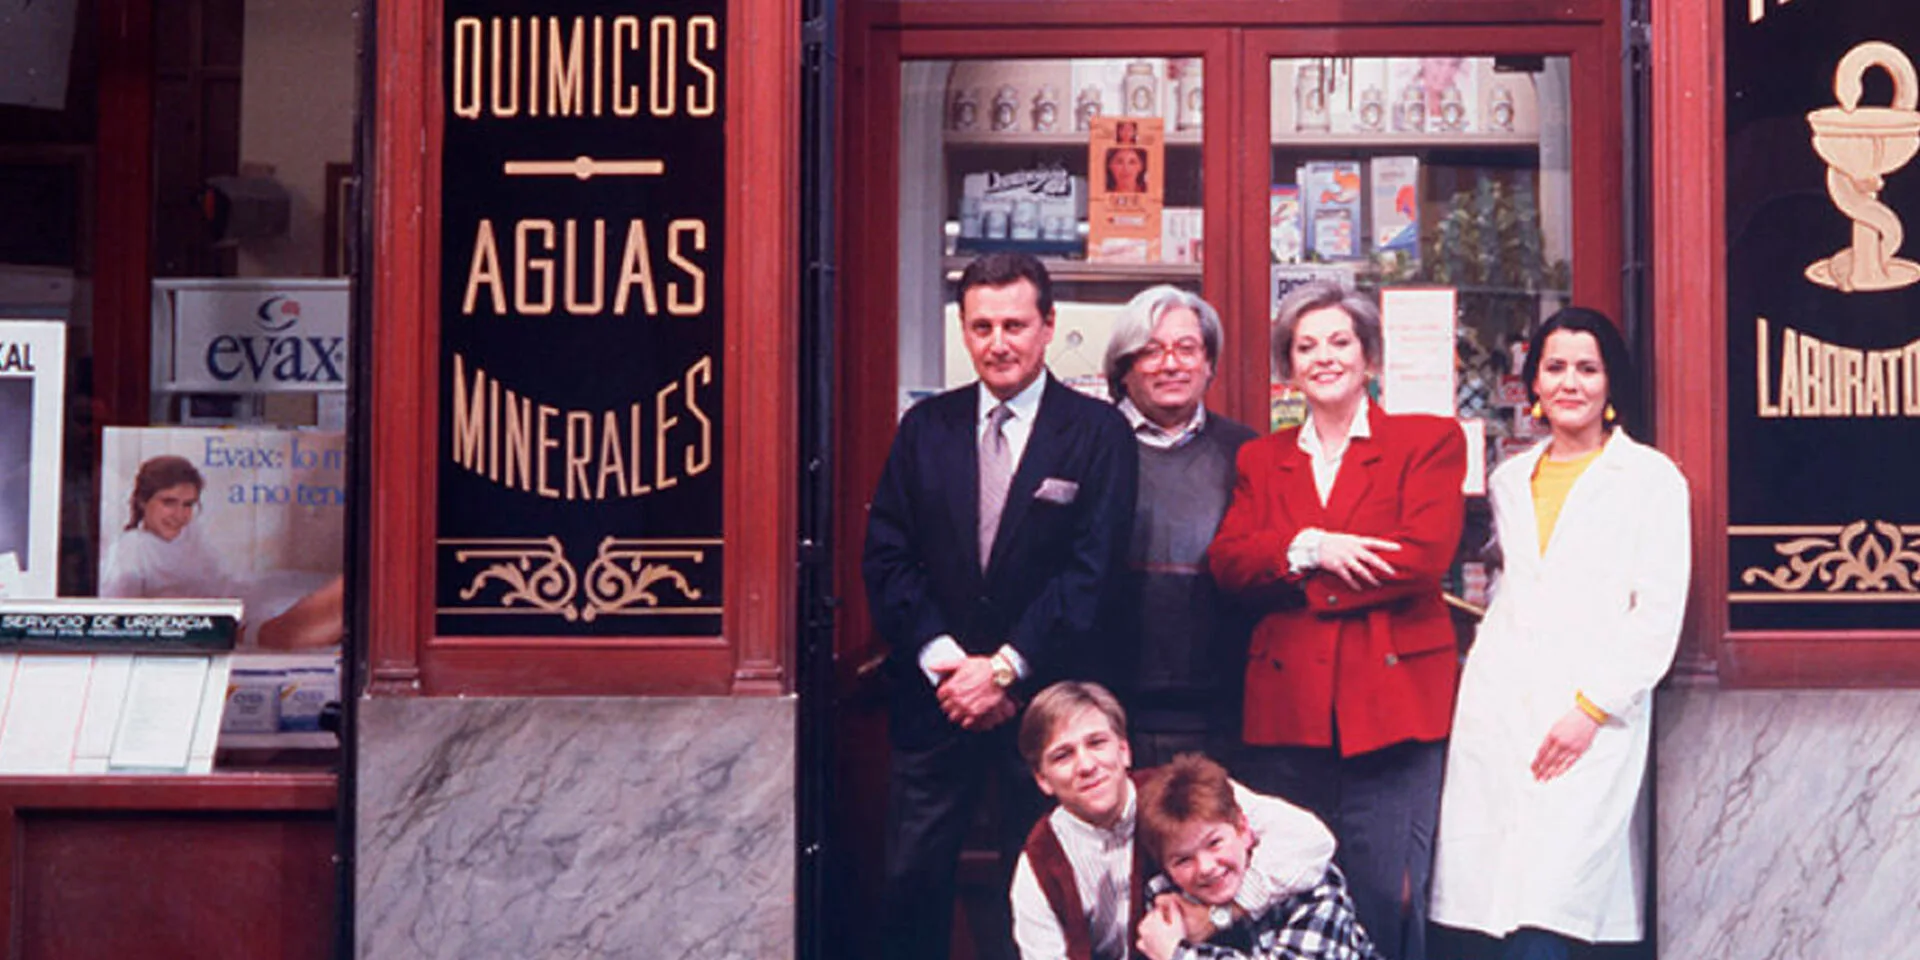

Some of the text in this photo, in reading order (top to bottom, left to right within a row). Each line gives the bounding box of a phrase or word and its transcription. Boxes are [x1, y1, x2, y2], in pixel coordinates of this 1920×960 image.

[454, 16, 716, 119] QUIMICOS
[462, 219, 706, 315] AGUAS
[206, 334, 343, 382] evax
[453, 353, 711, 500] MINERALES
[204, 436, 283, 468] Evax:
[291, 437, 318, 470] lo
[229, 483, 245, 504] a
[252, 483, 290, 504] no
[1, 615, 213, 629] SERVICIO DE URGENCIA
